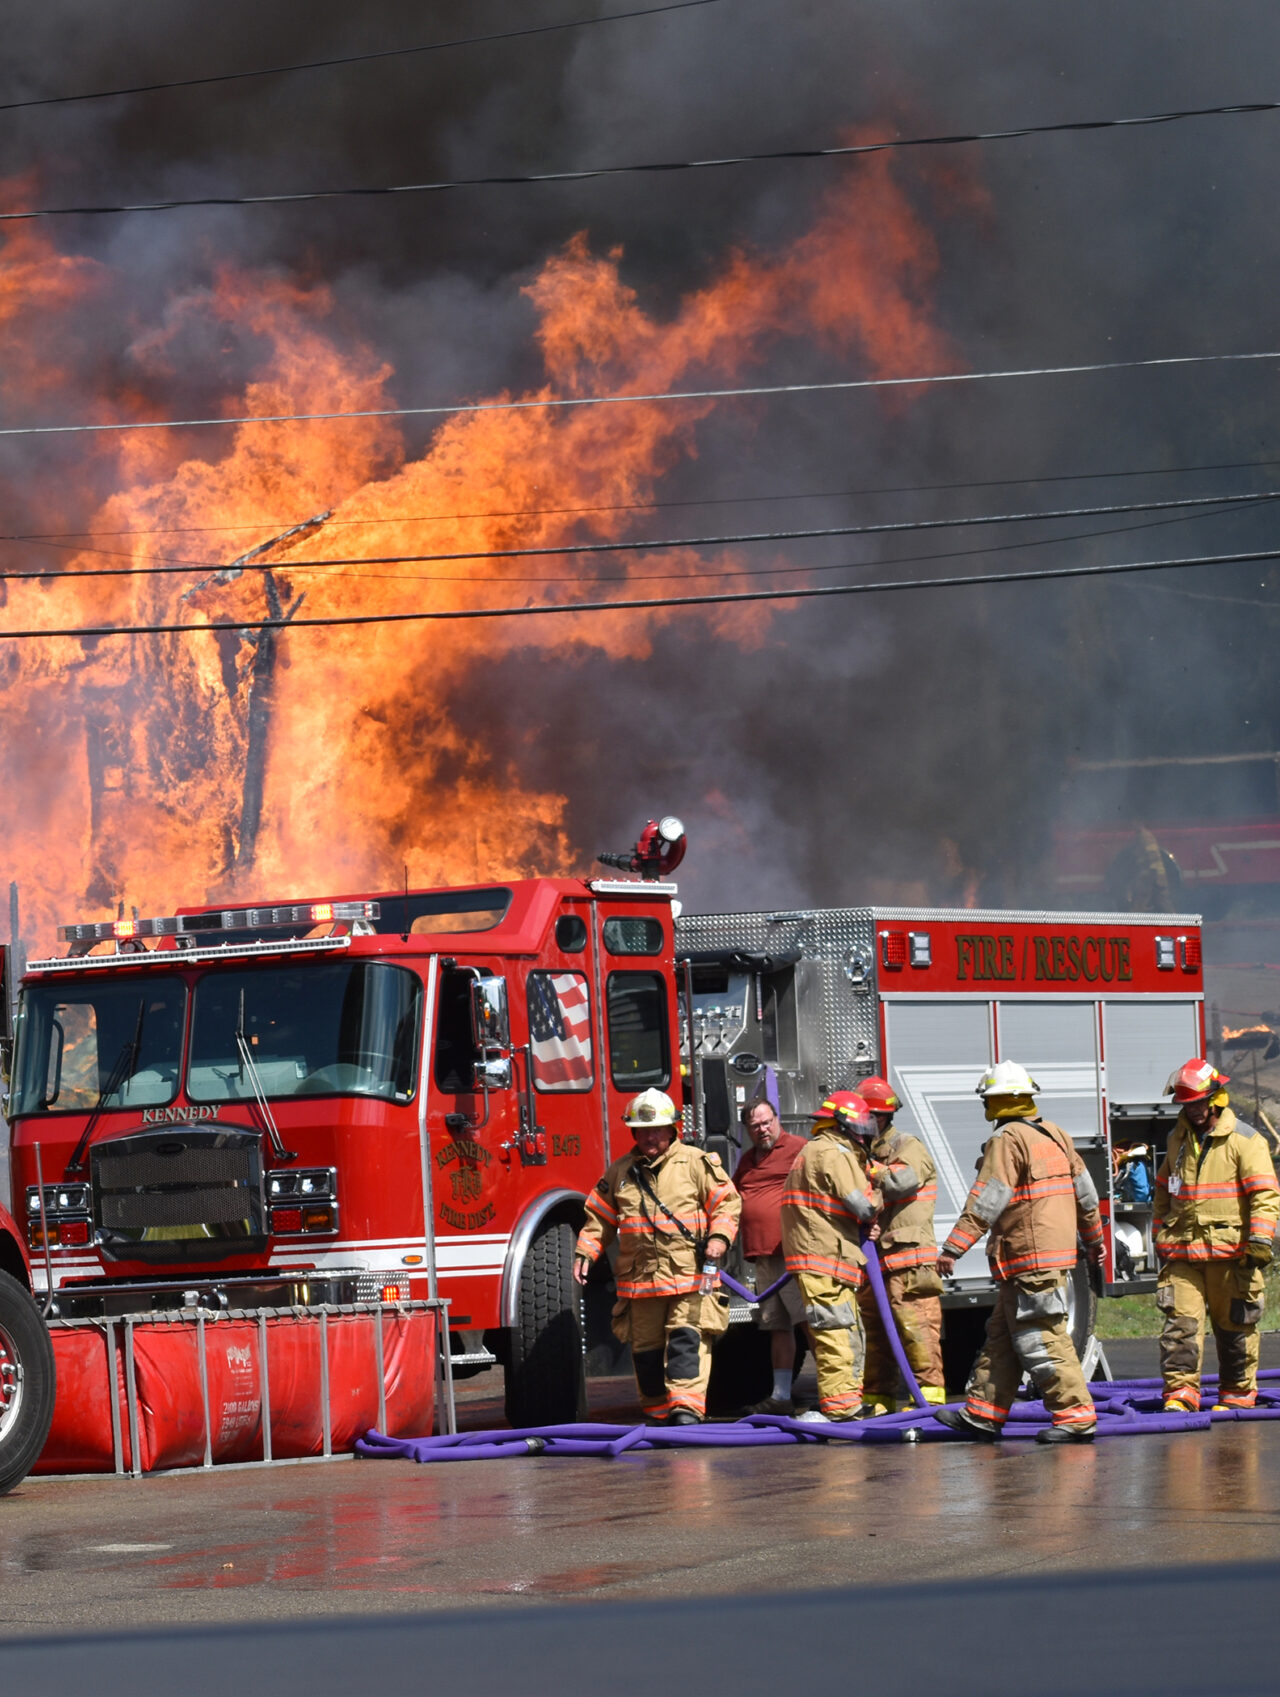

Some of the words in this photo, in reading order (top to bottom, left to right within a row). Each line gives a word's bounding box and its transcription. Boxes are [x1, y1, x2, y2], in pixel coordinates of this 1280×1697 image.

[955, 935, 1016, 981] FIRE
[1033, 936, 1133, 982] RESCUE
[142, 1105, 222, 1123] KENNEDY
[435, 1140, 493, 1169] KENNEDY
[552, 1134, 581, 1156] E473
[439, 1202, 467, 1229] FIRE
